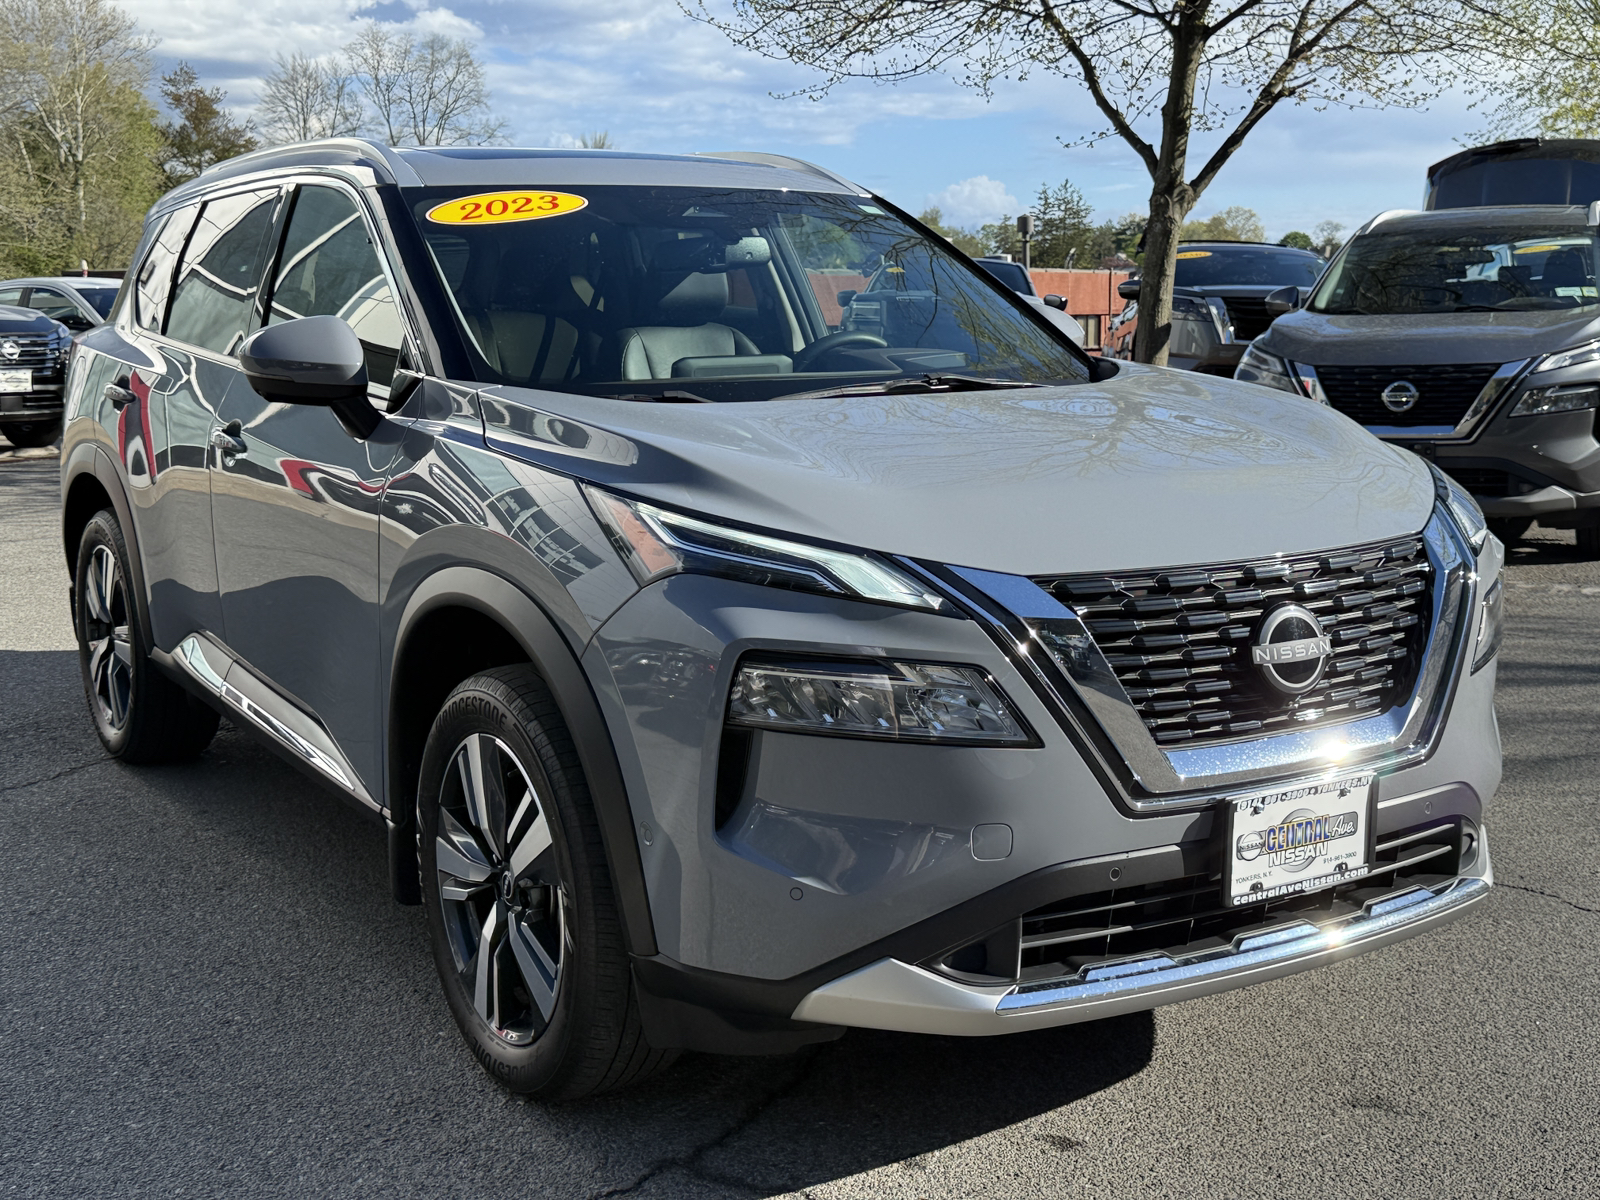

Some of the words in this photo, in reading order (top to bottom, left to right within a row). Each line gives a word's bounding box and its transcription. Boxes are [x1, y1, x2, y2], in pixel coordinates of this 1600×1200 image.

[460, 195, 560, 221] 2023
[1255, 639, 1330, 662] NISSAN
[1266, 814, 1331, 852] CENTRAL
[1331, 814, 1355, 837] Ave.
[1268, 842, 1329, 868] NISSAN
